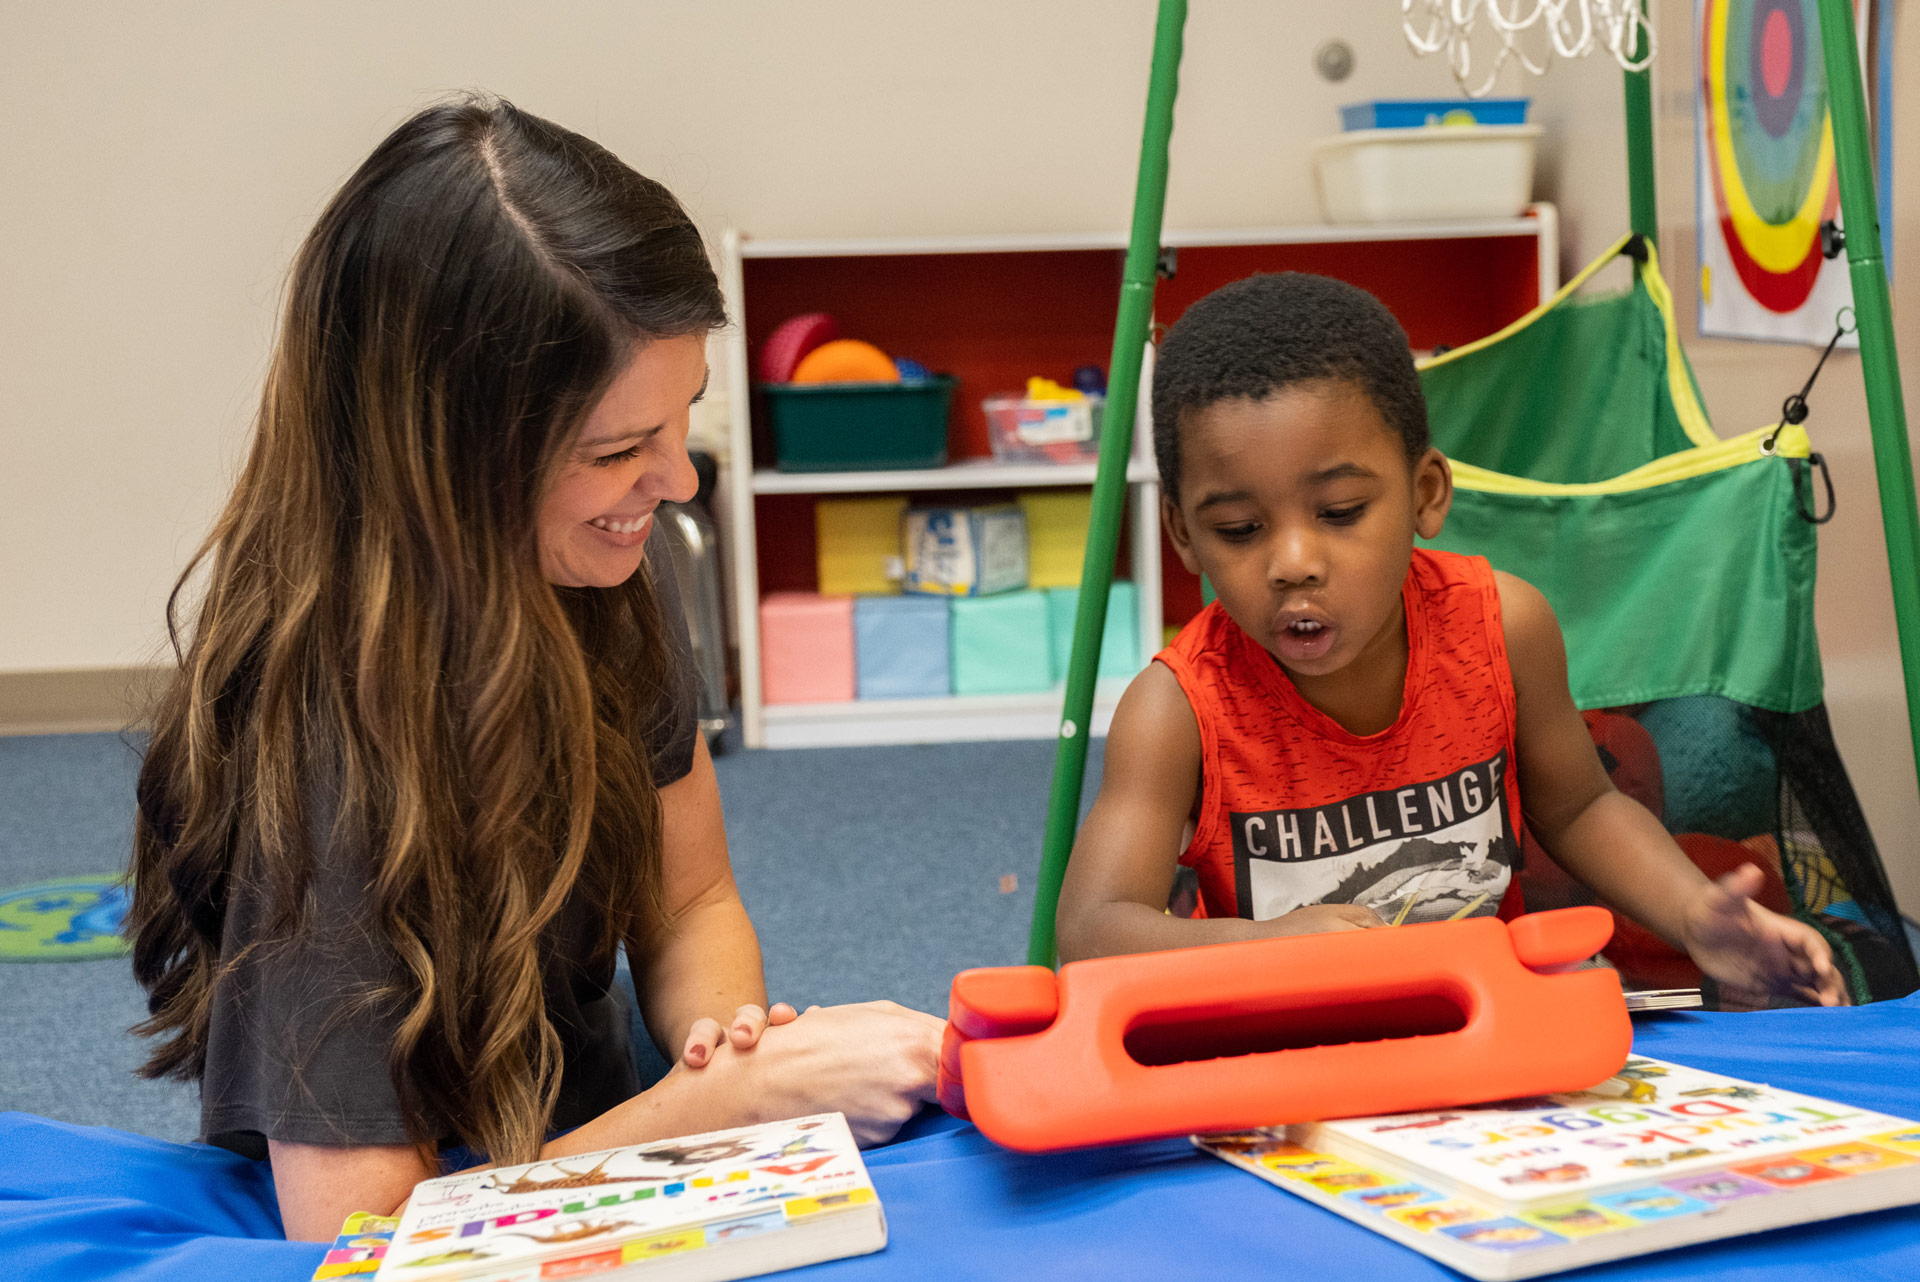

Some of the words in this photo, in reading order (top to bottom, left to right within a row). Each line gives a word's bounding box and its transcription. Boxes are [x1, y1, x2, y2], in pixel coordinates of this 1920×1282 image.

[1244, 757, 1502, 859] CHALLENGE
[1428, 1100, 1749, 1149] Diggers
[1581, 1106, 1866, 1149] Trucks
[408, 1154, 840, 1246] Animals
